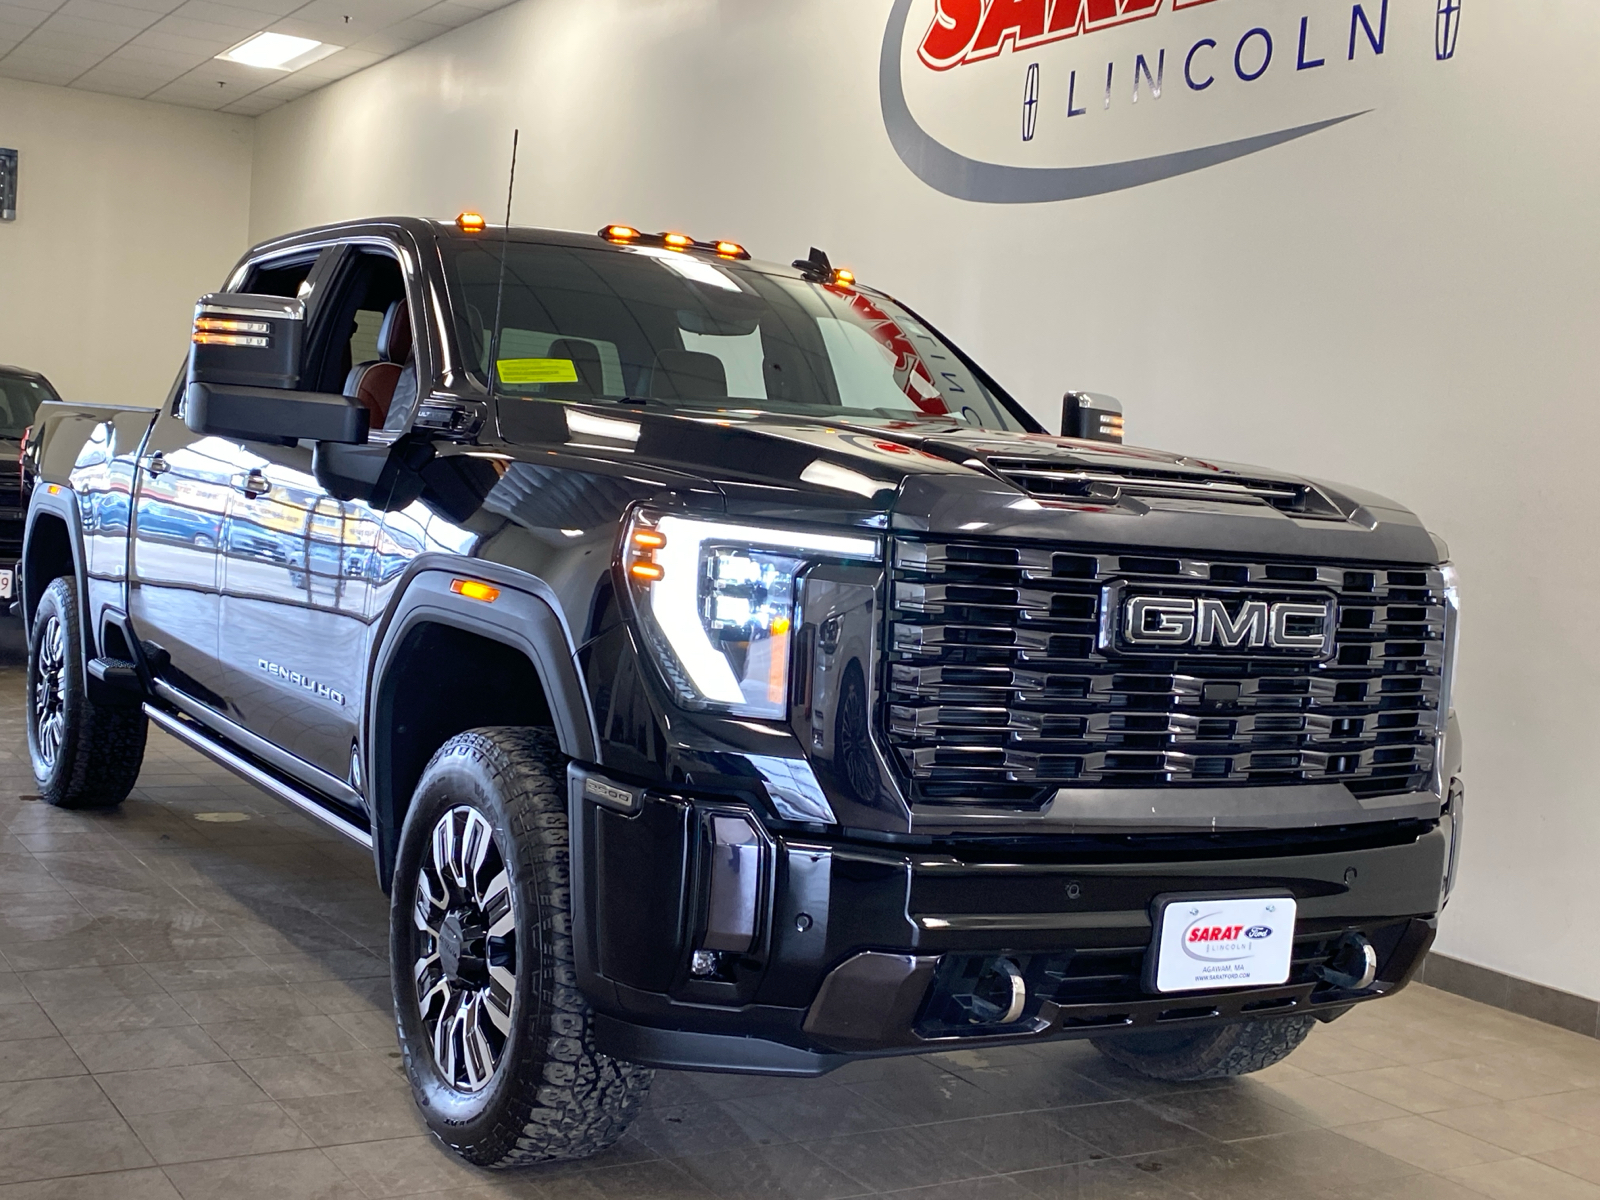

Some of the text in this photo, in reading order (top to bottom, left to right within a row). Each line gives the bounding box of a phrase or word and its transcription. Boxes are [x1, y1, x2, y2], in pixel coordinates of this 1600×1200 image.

[1067, 0, 1388, 117] LINCOLN
[1125, 596, 1327, 648] GMC
[258, 658, 318, 693] DENALI
[1188, 925, 1269, 942] SARAT Ford
[1211, 943, 1246, 951] LINCOLN
[1195, 973, 1250, 981] WWW.SARATFORD.COM
